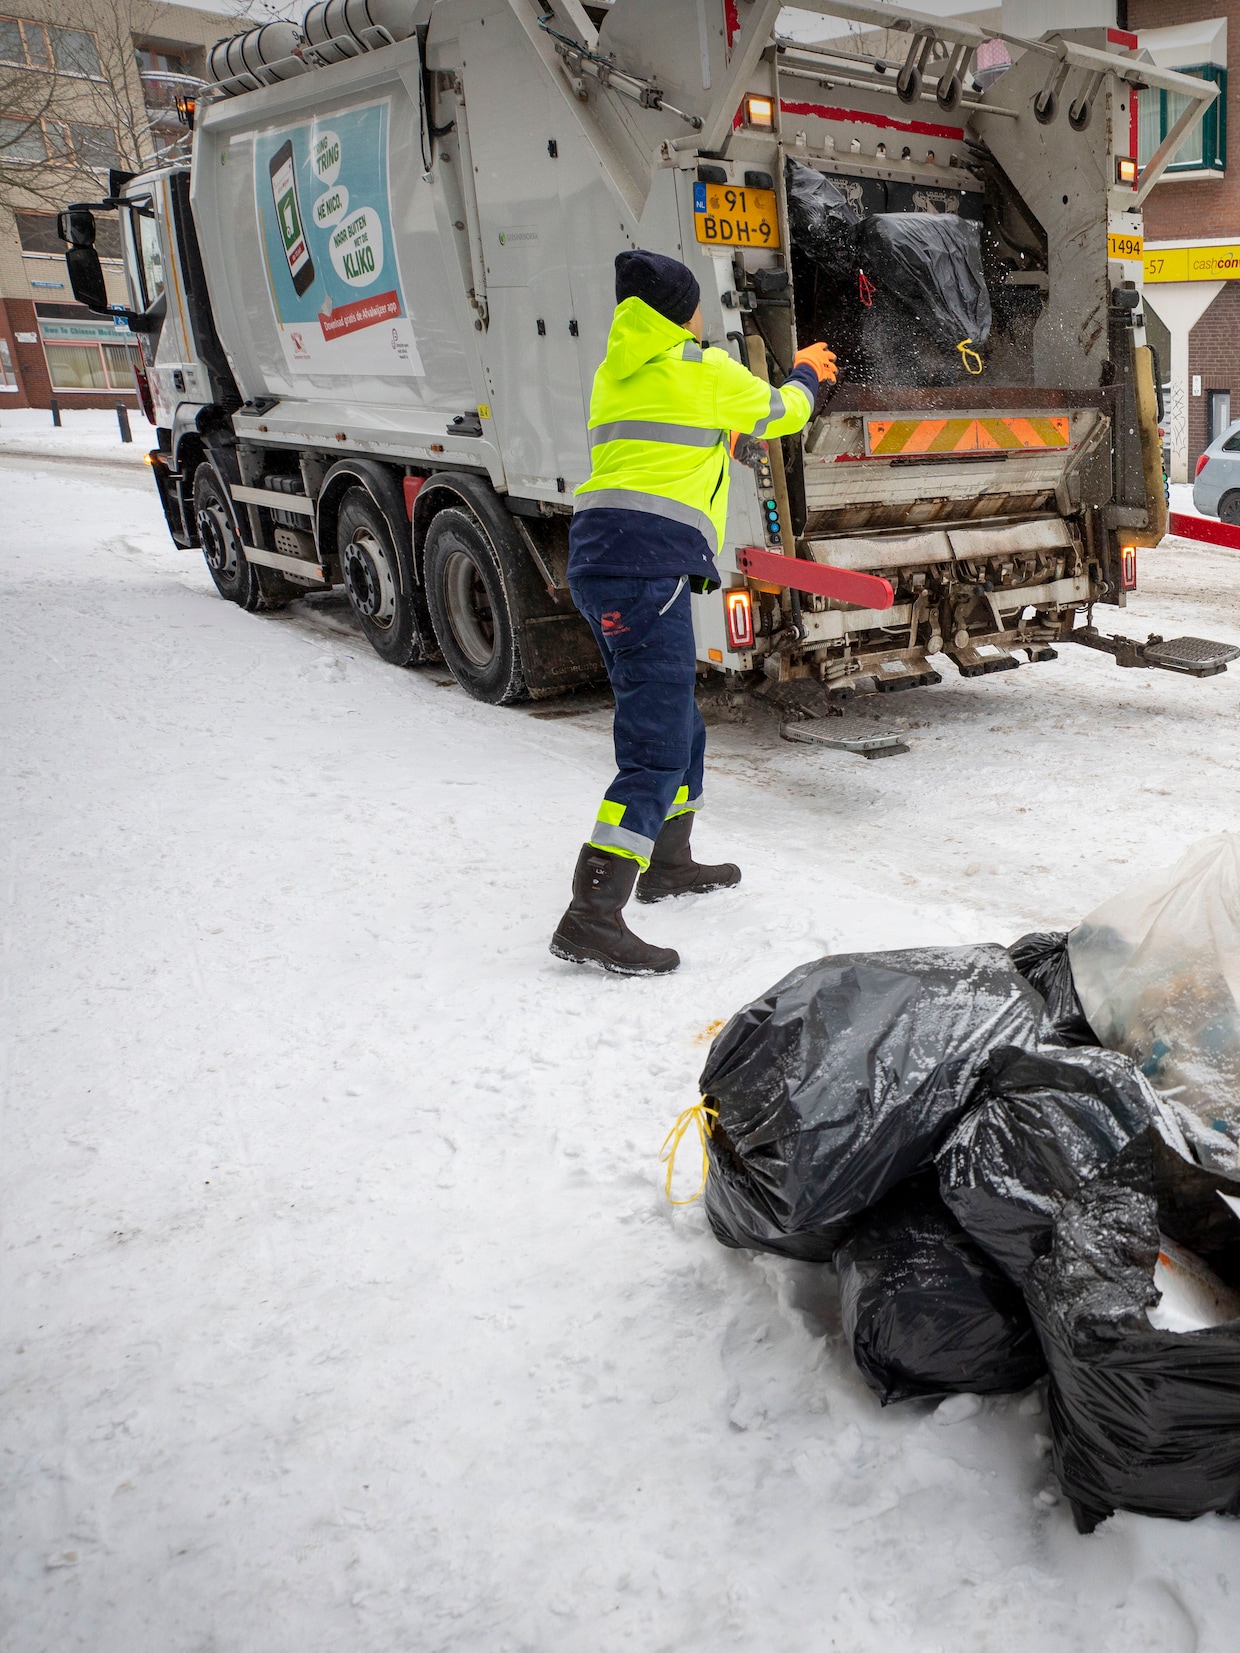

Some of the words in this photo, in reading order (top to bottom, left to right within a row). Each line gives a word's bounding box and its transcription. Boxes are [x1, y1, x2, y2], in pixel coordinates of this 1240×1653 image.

[316, 142, 340, 175] TRING
[695, 200, 706, 209] NL
[724, 190, 746, 213] 91
[347, 214, 367, 238] BUITEN
[704, 217, 771, 244] BDH-9
[1108, 238, 1140, 255] 1494
[343, 245, 375, 280] KLIKO
[323, 316, 344, 331] Download
[387, 302, 397, 314] app
